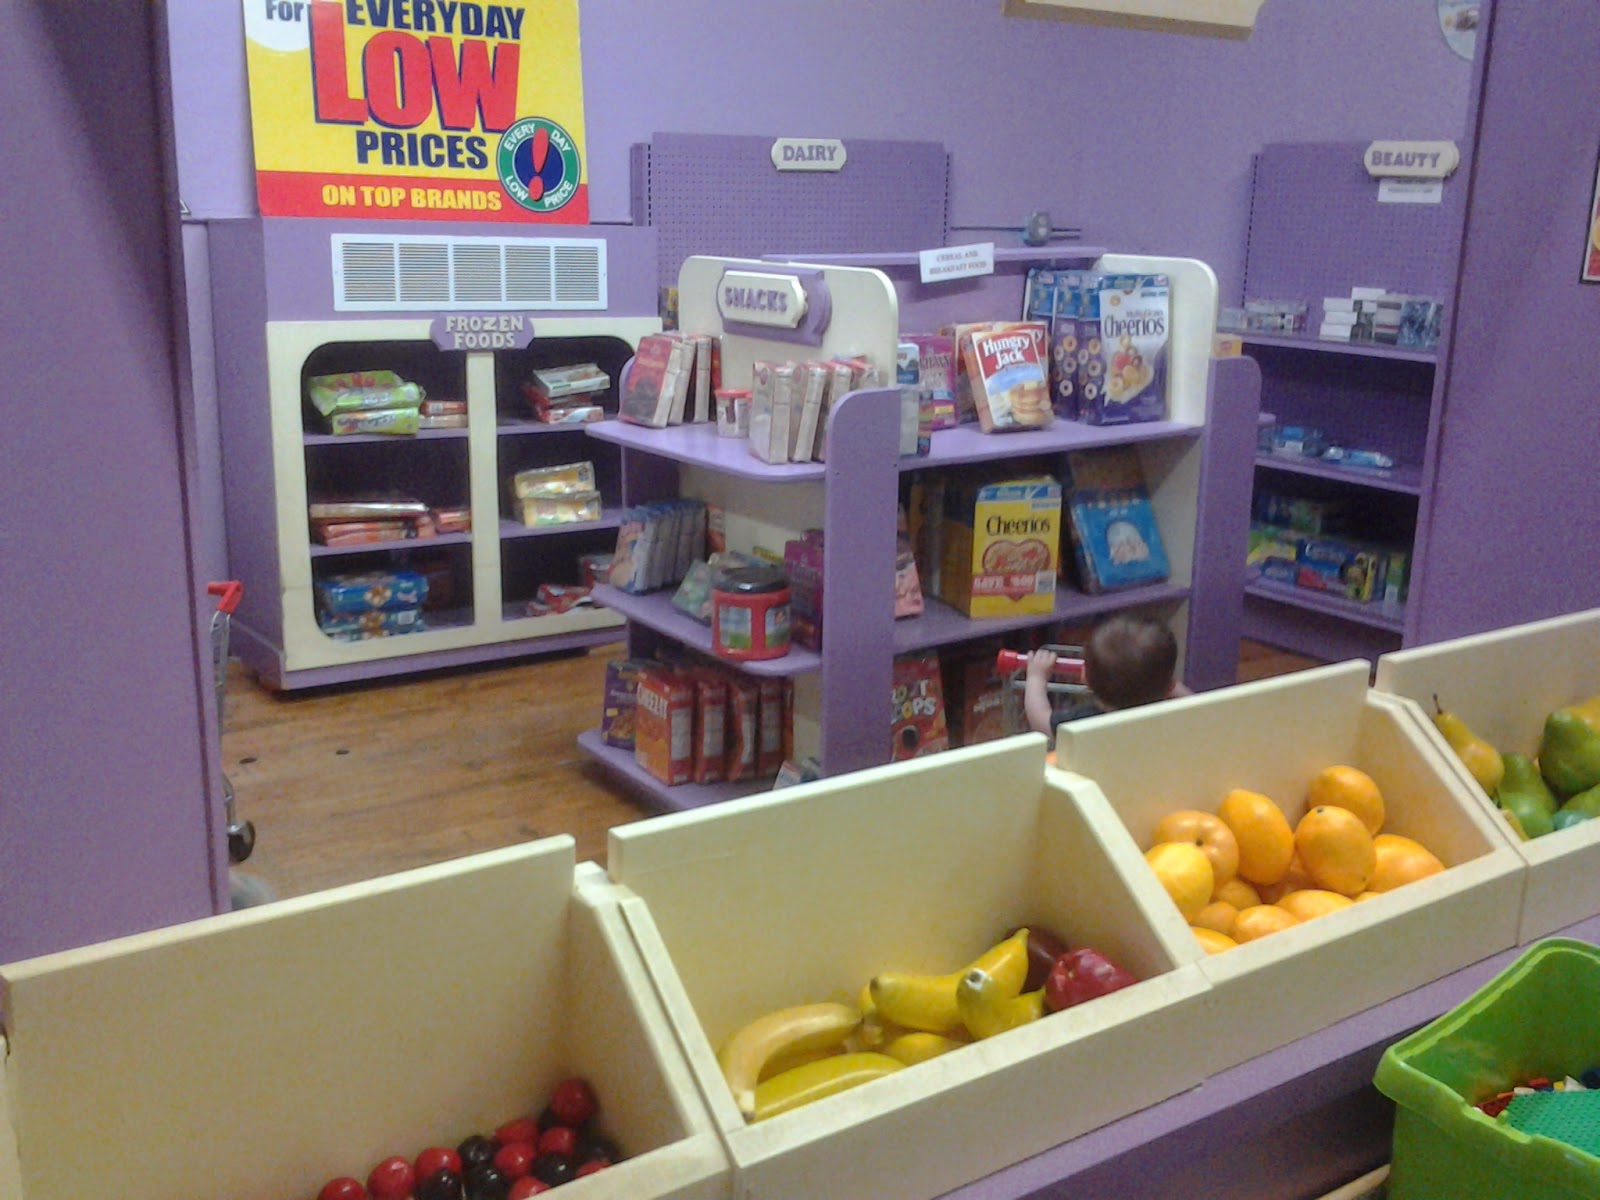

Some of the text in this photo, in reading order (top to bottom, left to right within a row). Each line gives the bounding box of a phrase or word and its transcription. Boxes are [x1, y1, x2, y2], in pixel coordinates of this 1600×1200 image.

[265, 0, 304, 22] For
[346, 0, 525, 40] EVERYDAY
[309, 0, 521, 135] LOW
[503, 122, 572, 152] EVERY DAY
[356, 130, 489, 170] PRICES
[782, 144, 837, 162] DAIRY
[1371, 150, 1441, 168] BEAUTY
[321, 184, 502, 211] ON TOP BRANDS
[505, 174, 574, 208] LOW PRICE
[724, 286, 788, 313] SNACKS
[445, 315, 524, 333] FROZEN
[1104, 314, 1165, 338] Cheerios
[454, 331, 516, 349] FOODS
[982, 335, 1030, 358] Hungry
[994, 347, 1026, 371] Jack
[986, 515, 1051, 536] Cheerios
